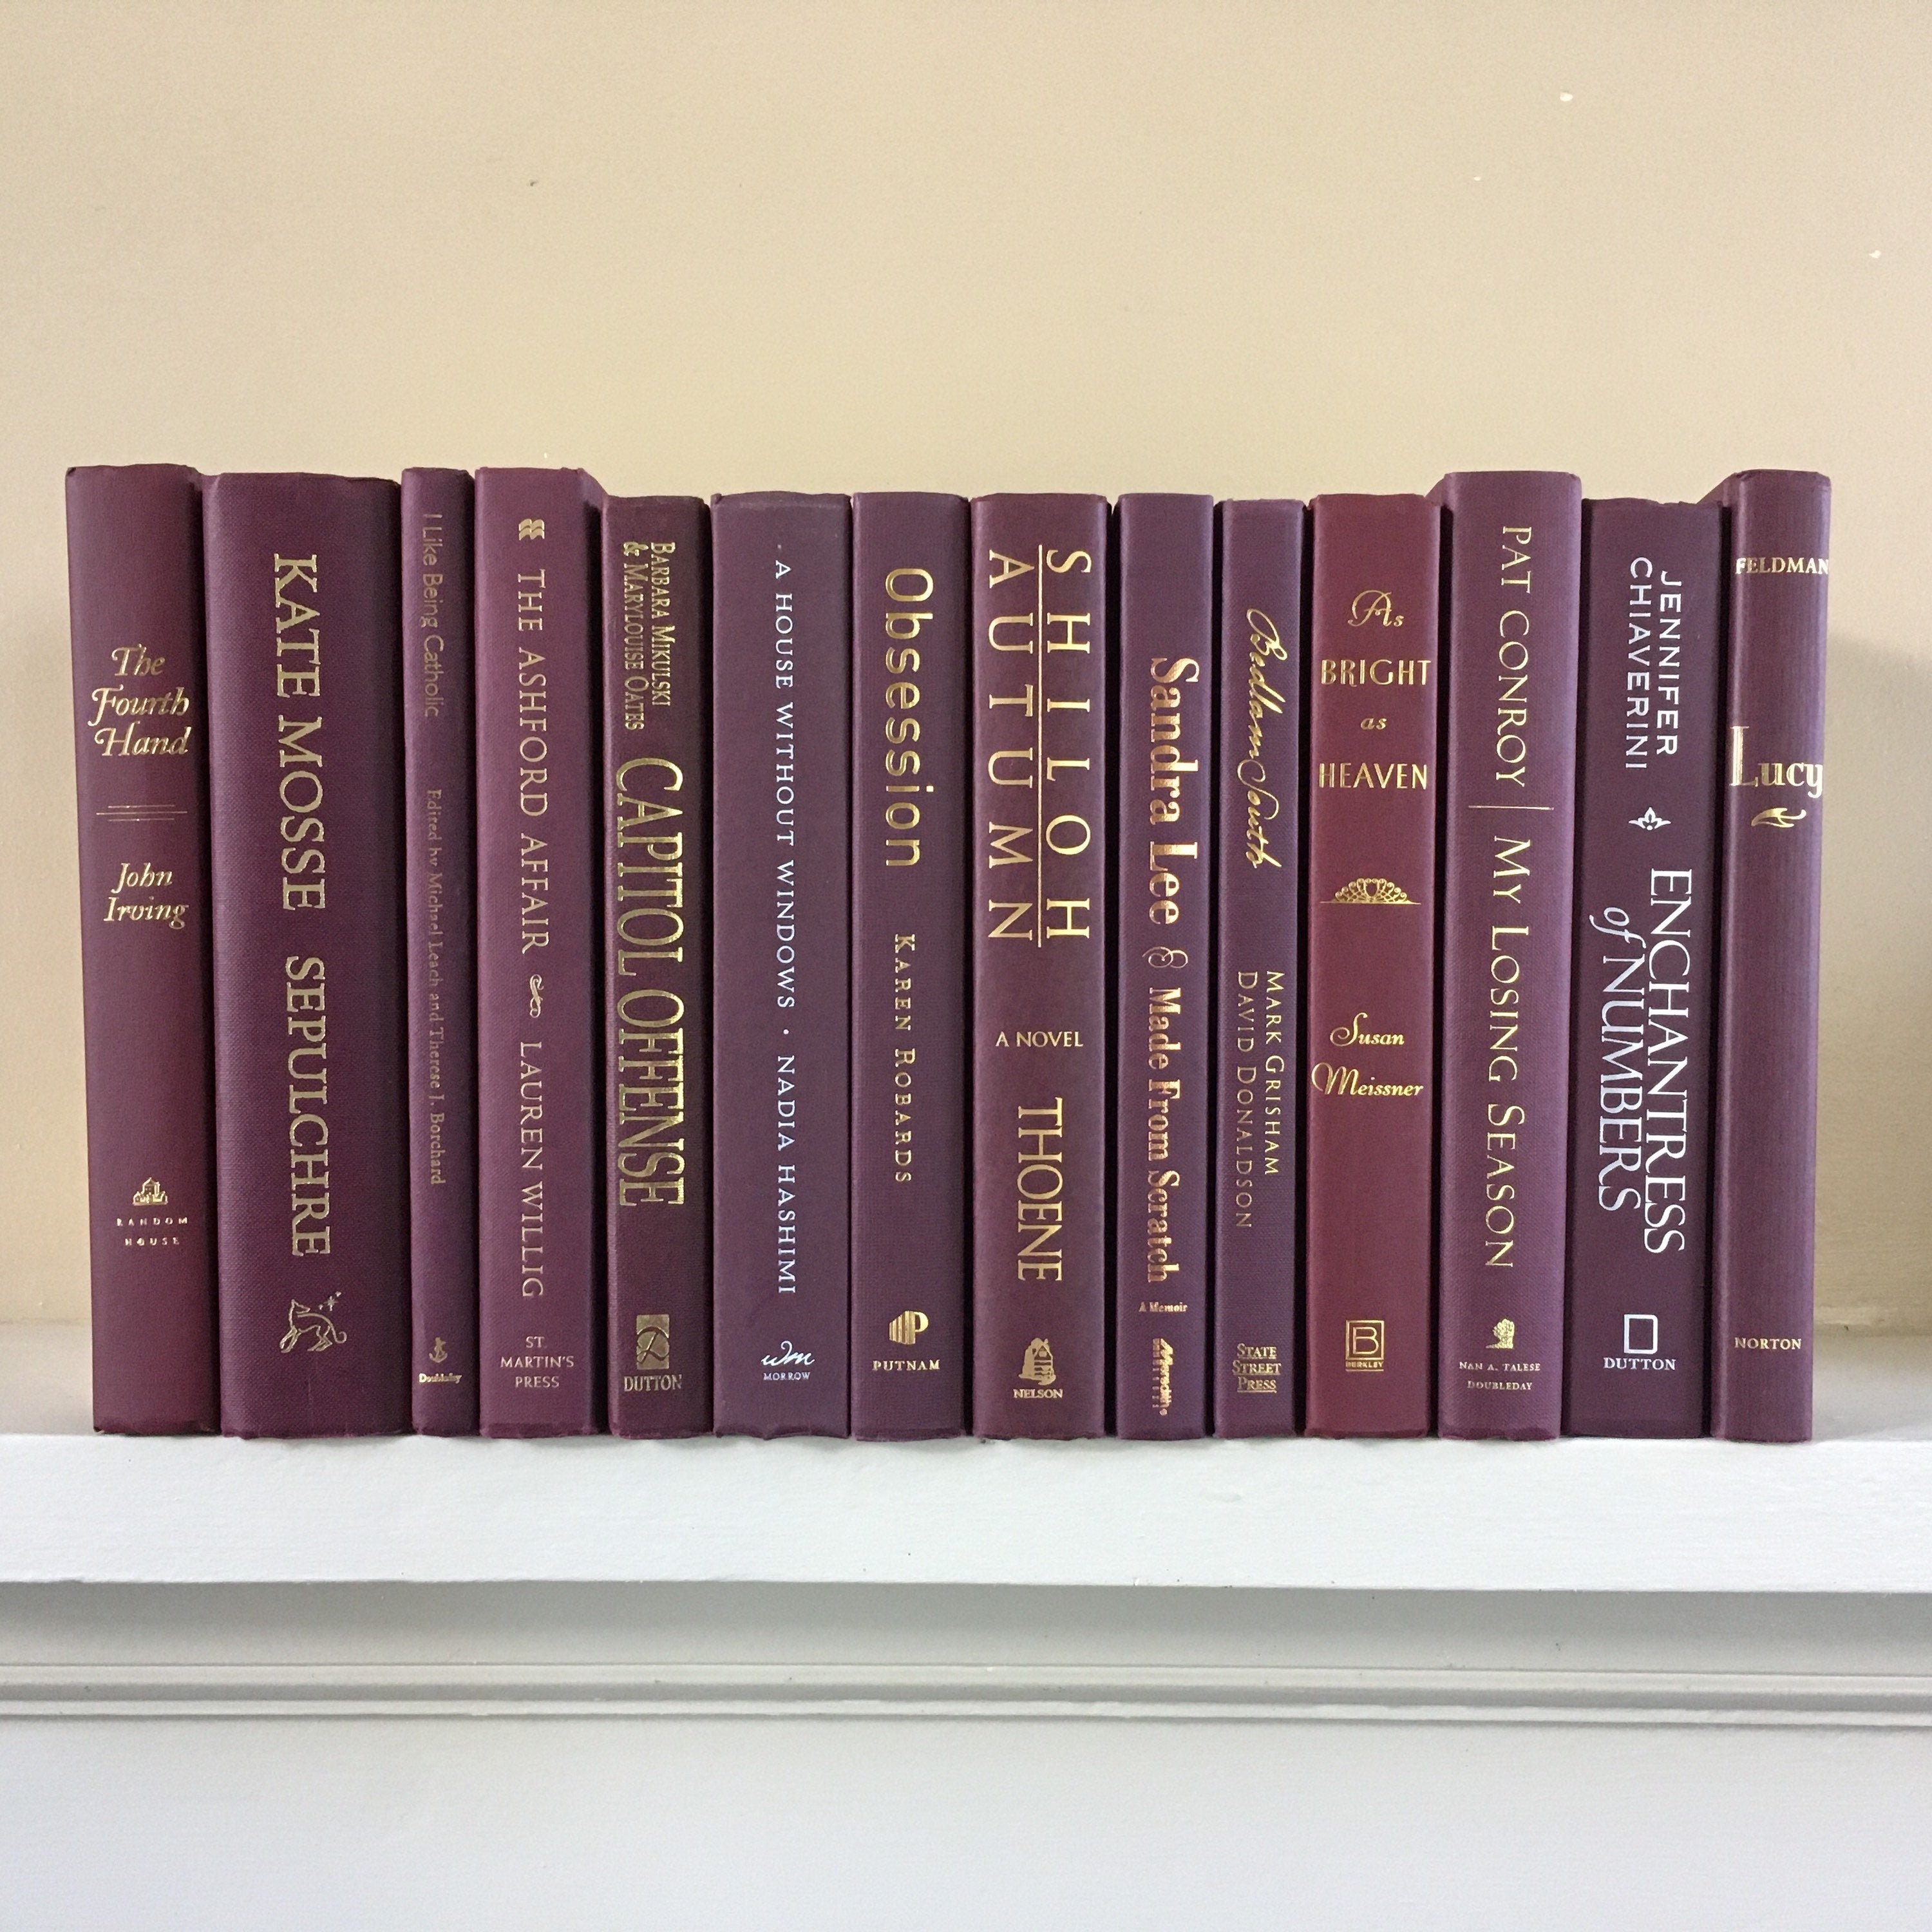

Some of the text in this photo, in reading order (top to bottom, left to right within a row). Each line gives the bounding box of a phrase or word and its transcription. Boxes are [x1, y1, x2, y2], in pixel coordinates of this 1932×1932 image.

[422, 527, 443, 565] Like
[1735, 557, 1828, 574] FELDMAN
[420, 574, 443, 628] Being
[1348, 591, 1404, 627] As
[623, 542, 649, 730] & MARYLOUISE OATES
[650, 542, 676, 706] BARBARA MIKULSKI
[111, 644, 165, 676] The
[423, 635, 445, 717] Catholic
[1321, 659, 1431, 687] BRIGHT
[1496, 526, 1531, 787] PAT CONROY
[1625, 558, 1653, 768] CHIAVERINI
[1656, 571, 1681, 754] JENNIFER
[90, 685, 190, 726] Fourth
[886, 569, 934, 866] Obsession
[1361, 718, 1387, 730] as
[94, 722, 191, 756] Hand
[274, 553, 325, 910] KATE MOSSE
[988, 550, 1034, 940] AUTUMN
[1045, 549, 1092, 939] SHILOH
[1237, 609, 1287, 869] Bedlam South
[518, 569, 549, 954] THE ASHFORD AFFAIR
[775, 560, 795, 1007] A HOUSE WITHOUT WINDOWS
[1320, 763, 1427, 790] HEAVEN
[1728, 725, 1823, 798] Lucy
[1150, 658, 1199, 924] Sandra Lee
[112, 862, 172, 893] John
[104, 896, 189, 929] Irving
[428, 872, 443, 935] Michael
[428, 942, 444, 986] Leach
[614, 758, 685, 1206] CAPITOL OFFENSE
[428, 993, 444, 1021] and
[1330, 1012, 1405, 1046] Susan
[429, 1027, 445, 1088] Therese
[895, 934, 915, 1181] KAREN ROBARDS
[996, 1032, 1083, 1046] A NOVEL
[1486, 836, 1530, 1267] MY LOSING SEASON
[1589, 907, 1646, 1213] of NUMBERS
[1643, 868, 1692, 1253] ENCHANTRESS
[1265, 971, 1284, 1175] MARK GRISHAM
[1311, 1063, 1423, 1095] Meissner
[285, 956, 330, 1256] SEPULCHRE
[429, 1094, 445, 1106] J.
[1236, 971, 1258, 1227] DAVID DONALDSON
[429, 1112, 446, 1184] Borchard
[1148, 988, 1180, 1282] Made From Scratch
[520, 1042, 543, 1296] LAUREN WILLIG
[778, 1056, 795, 1293] NADIA HASHIMI
[1018, 1097, 1063, 1281] THOENE
[117, 1217, 187, 1226] RANDOM
[126, 1237, 179, 1245] HOUSE
[1139, 1302, 1188, 1312] A Memoir
[501, 1356, 574, 1367] MARTIN'S
[873, 1359, 940, 1370] PUTNAM
[1236, 1343, 1276, 1358] STATE
[1459, 1361, 1482, 1370] NAN
[1604, 1356, 1676, 1370] DUTTON
[1735, 1338, 1801, 1349] NORTON
[516, 1376, 559, 1388] PRESS
[624, 1374, 681, 1391] DUTTON
[1232, 1359, 1282, 1374] STREET
[1237, 1376, 1276, 1390] PRESS
[1468, 1381, 1532, 1390] DOUBLEDAY
[1013, 1389, 1063, 1398] NELSON
